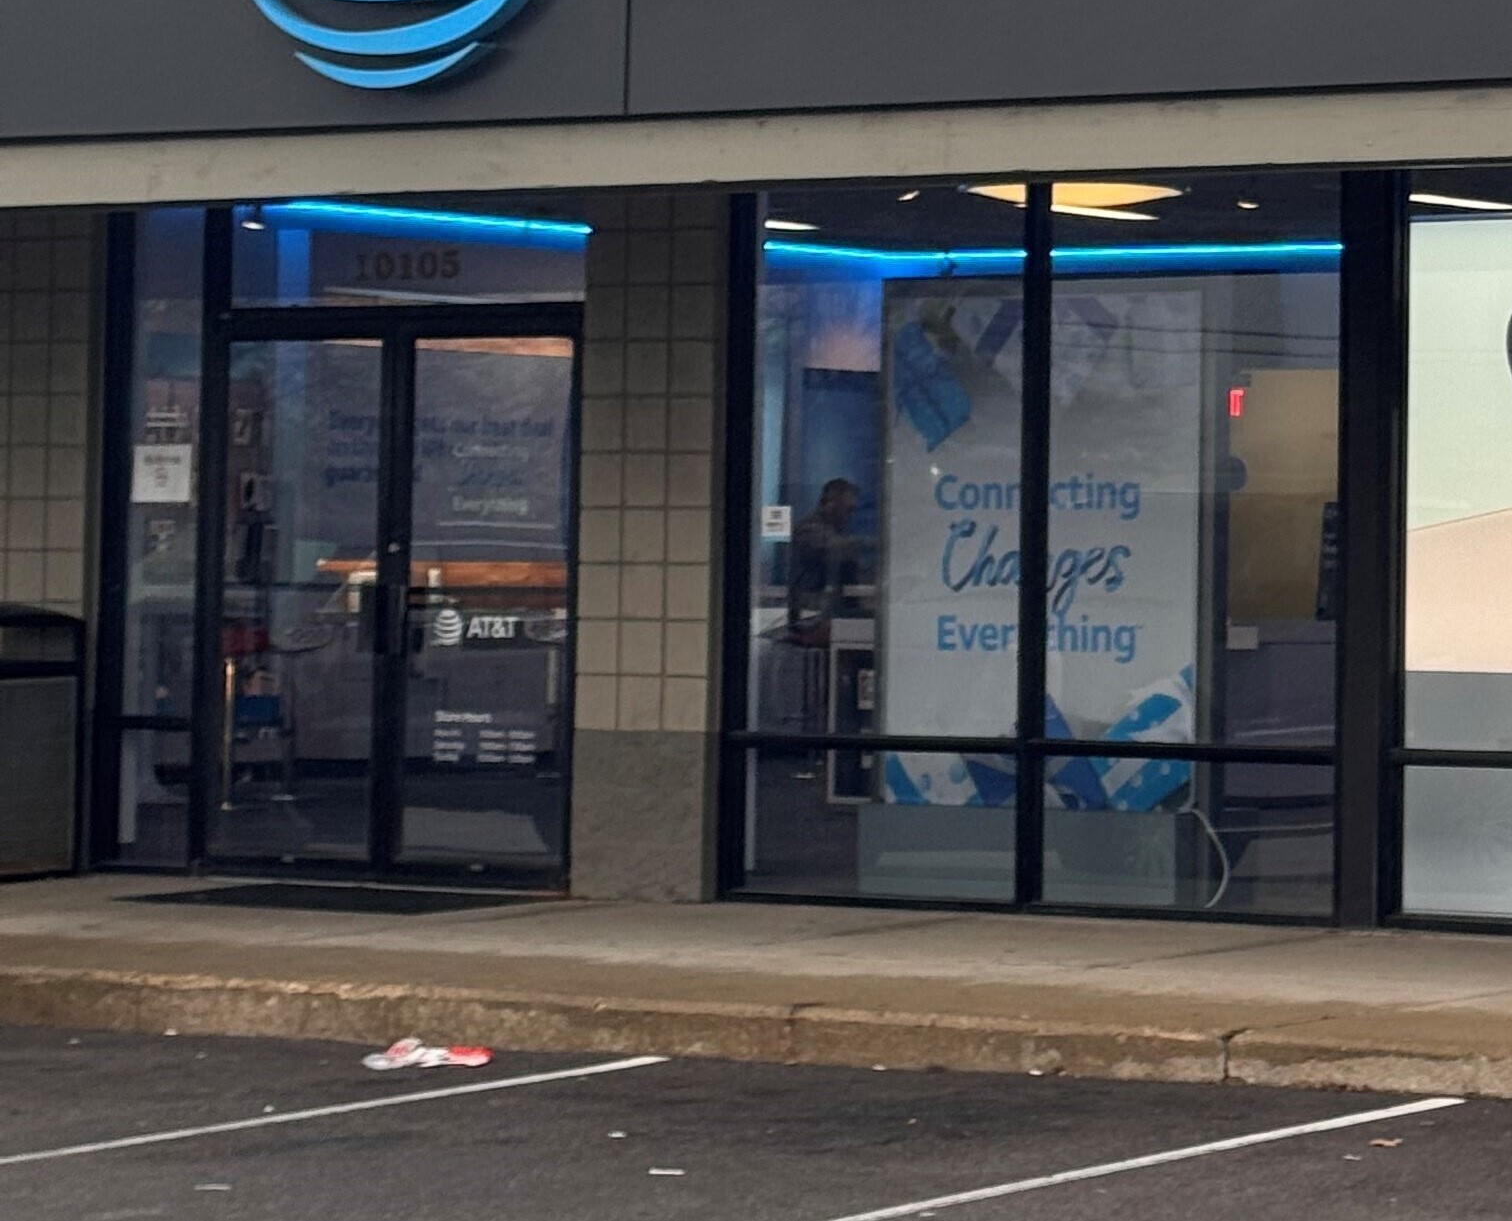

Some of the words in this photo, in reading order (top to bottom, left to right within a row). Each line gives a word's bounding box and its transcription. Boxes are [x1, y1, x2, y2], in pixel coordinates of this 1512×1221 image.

[355, 249, 462, 282] 10105
[934, 472, 1141, 520] Conncting
[941, 518, 1131, 614] Chages
[466, 616, 521, 638] AT&T
[937, 614, 1137, 664] Everhing
